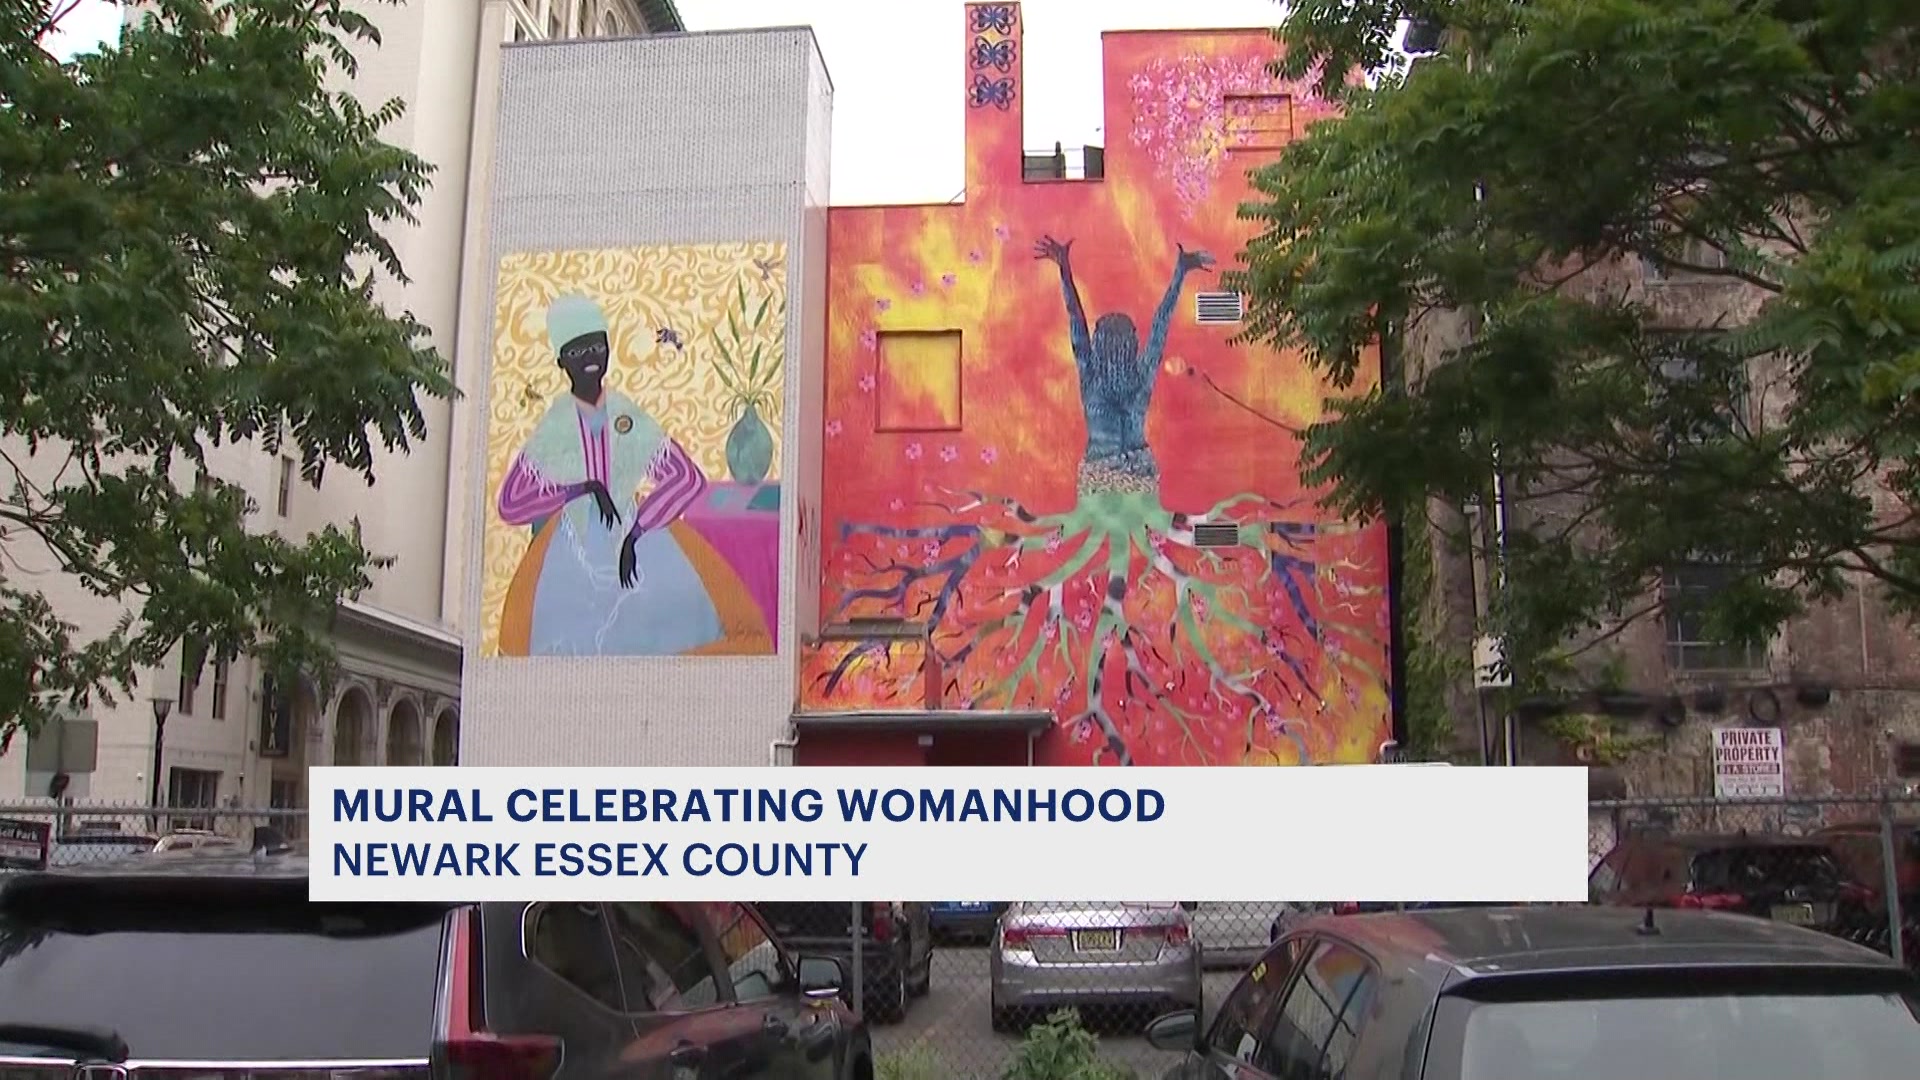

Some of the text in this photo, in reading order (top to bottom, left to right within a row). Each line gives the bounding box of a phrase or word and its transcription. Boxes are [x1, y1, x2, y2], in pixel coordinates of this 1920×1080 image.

[1721, 731, 1771, 745] PRIVATE
[1716, 746, 1778, 761] PROPERTY
[16, 829, 38, 840] Park
